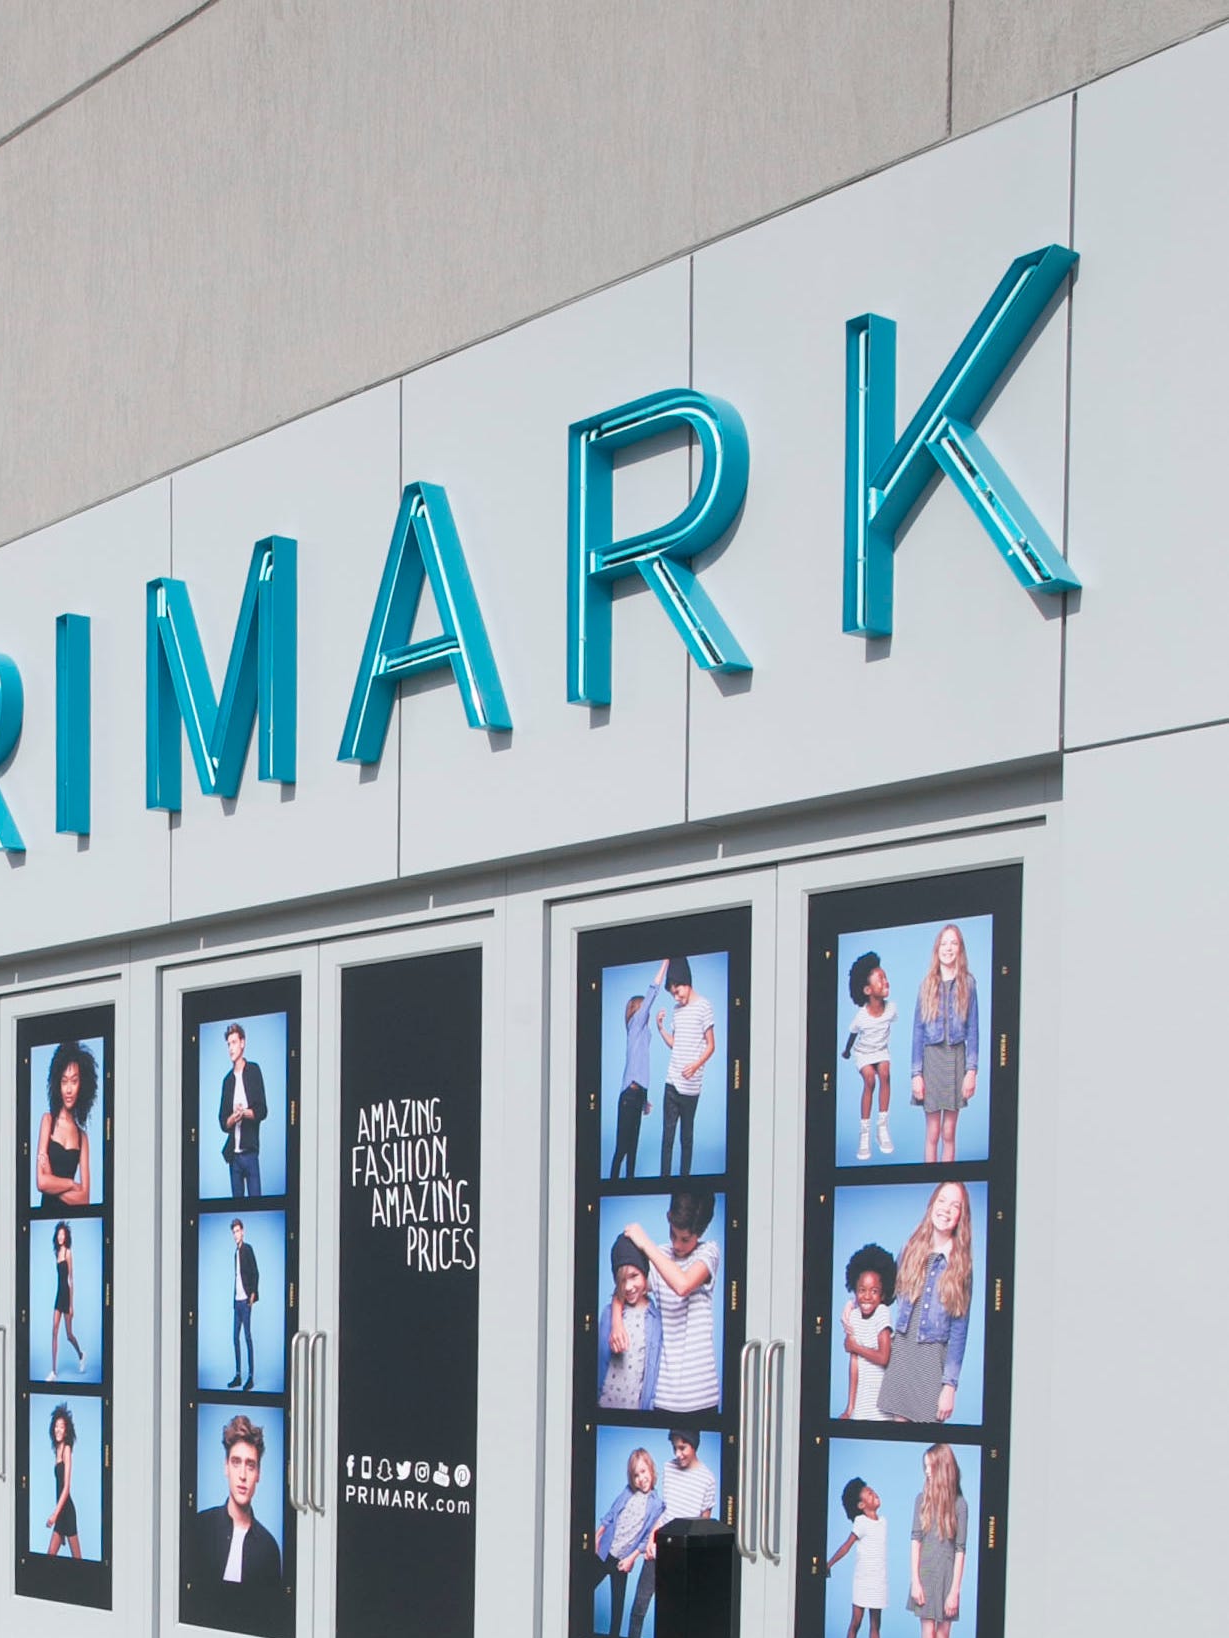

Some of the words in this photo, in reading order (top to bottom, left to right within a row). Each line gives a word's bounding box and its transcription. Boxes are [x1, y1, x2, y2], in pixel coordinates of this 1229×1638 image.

[357, 1097, 443, 1144] AMAZING
[352, 1135, 451, 1188] FASHION,
[371, 1179, 471, 1228] AMAZING
[406, 1225, 477, 1273] PRICES
[345, 1484, 471, 1515] PRIMARK.com
